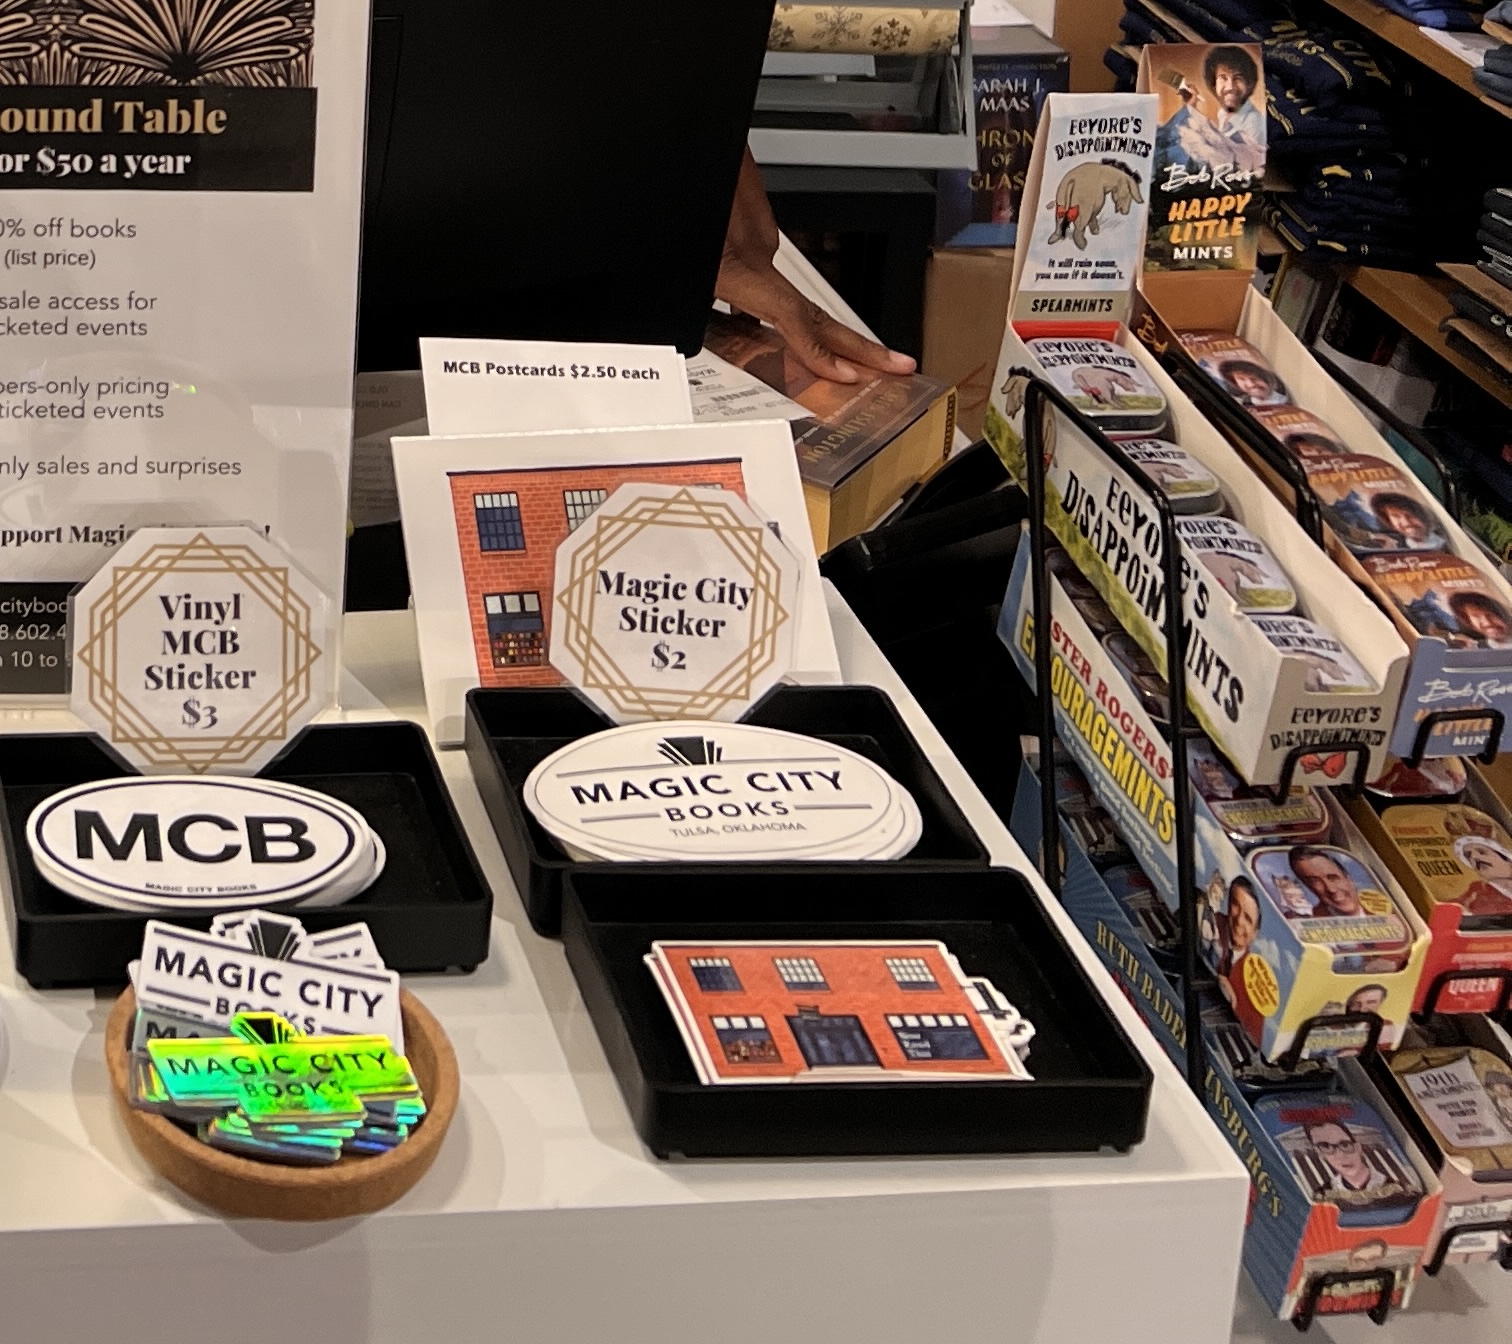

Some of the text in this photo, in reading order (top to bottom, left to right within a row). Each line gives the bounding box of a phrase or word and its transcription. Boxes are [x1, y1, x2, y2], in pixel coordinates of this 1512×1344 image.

[971, 77, 1028, 93] SARAH
[113, 99, 228, 135] Table
[980, 97, 1030, 112] MAAS
[36, 146, 93, 178] $50
[99, 155, 117, 174] a
[123, 154, 192, 179] year
[1168, 192, 1252, 222] HAPPY
[33, 218, 137, 239] off books
[1168, 217, 1246, 245] LITTLE
[4, 248, 97, 270] (list price)
[1173, 246, 1233, 260] MINTS
[48, 290, 158, 311] access for
[1031, 298, 1114, 312] SPEARMINTS
[443, 360, 660, 380] MCB Postcards $2.50 each
[92, 403, 165, 420] events
[595, 569, 755, 611] Magic City
[159, 592, 242, 626] Vinyl
[618, 606, 727, 639] Sticker
[161, 629, 240, 656] MCB
[651, 640, 687, 673] $2
[144, 663, 257, 691] Sticker
[181, 696, 218, 729] $3
[570, 770, 841, 806] MAGIC CITY
[665, 801, 790, 823] BOOKS
[74, 809, 317, 864] MCB
[669, 822, 807, 838] TULSA, OKLAHOMA
[1420, 860, 1462, 878] QUEEN
[1095, 919, 1139, 983] RUTH
